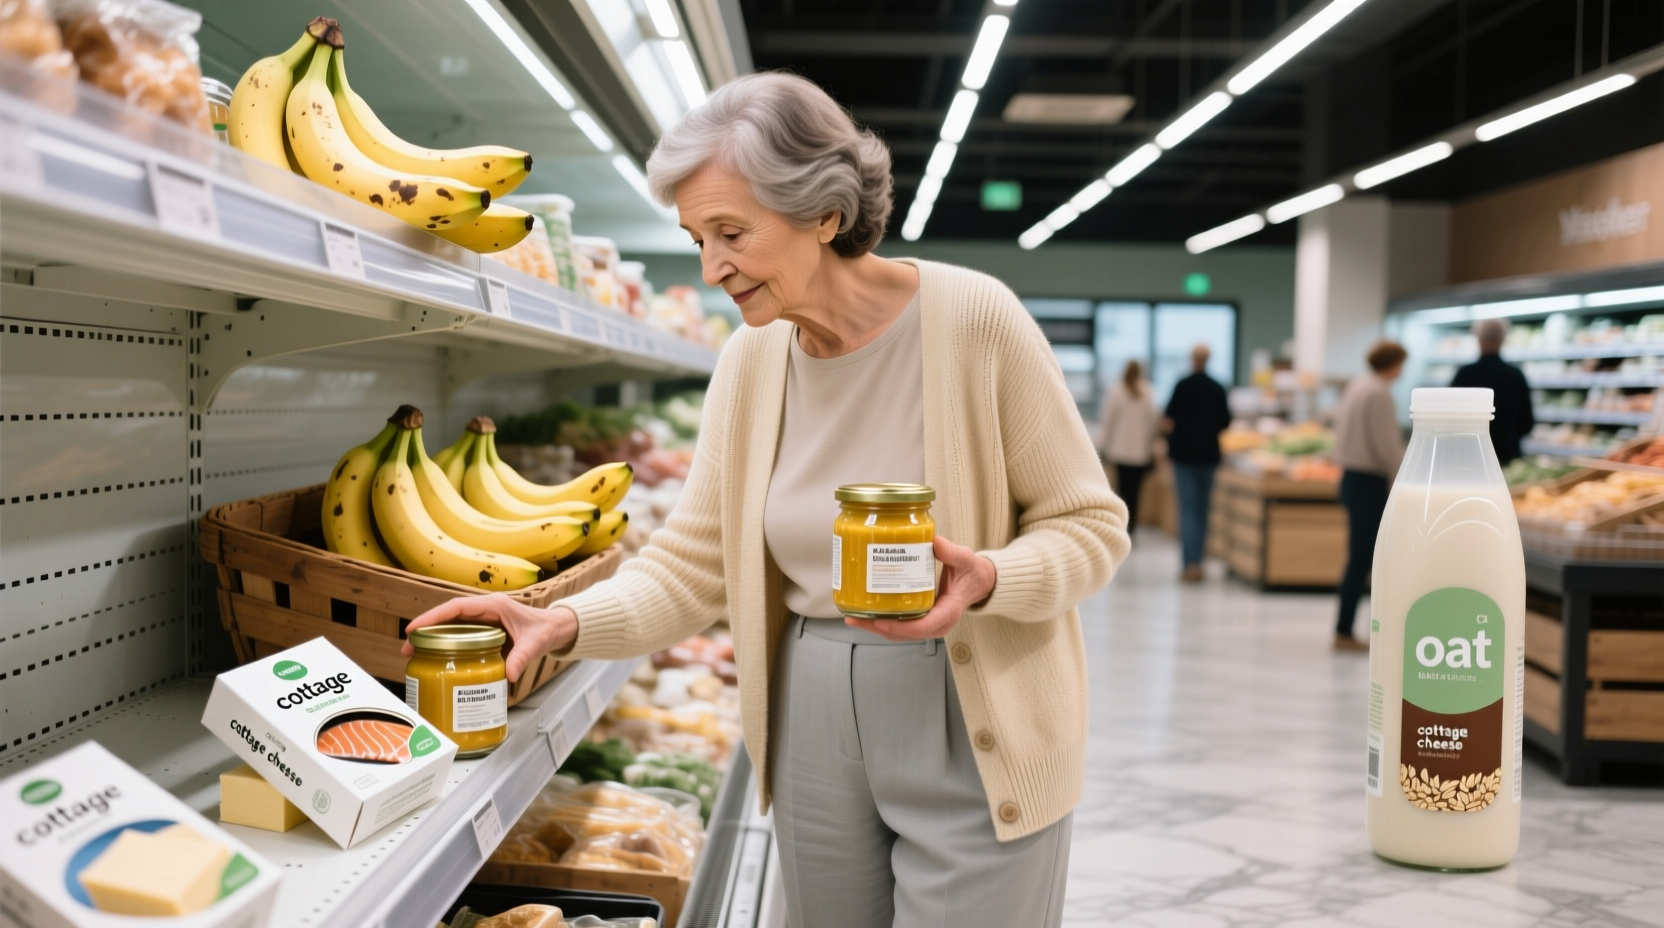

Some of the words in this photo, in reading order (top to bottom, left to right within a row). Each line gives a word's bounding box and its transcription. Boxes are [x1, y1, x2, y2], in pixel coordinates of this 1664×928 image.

[1416, 629, 1492, 669] oat
[277, 672, 352, 710] cottage
[1417, 724, 1468, 741] cottage
[16, 785, 122, 846] cottage
